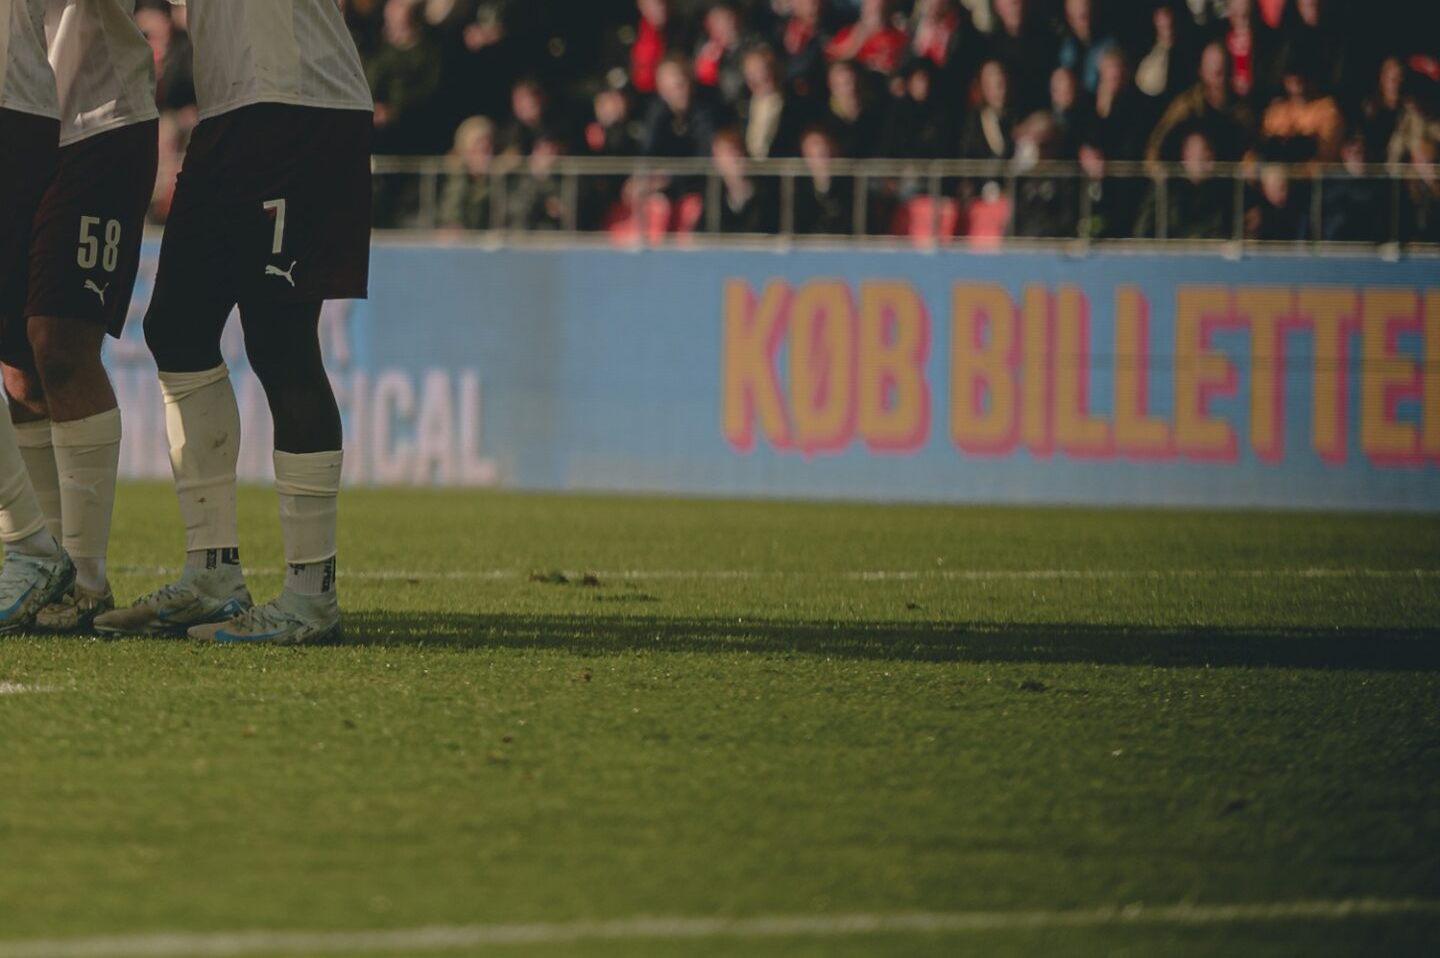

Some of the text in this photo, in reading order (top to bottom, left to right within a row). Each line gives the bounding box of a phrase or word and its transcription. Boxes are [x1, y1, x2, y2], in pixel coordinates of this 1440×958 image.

[76, 215, 121, 272] 58
[263, 198, 286, 255] 7
[722, 276, 1440, 470] KØB BILLETTE
